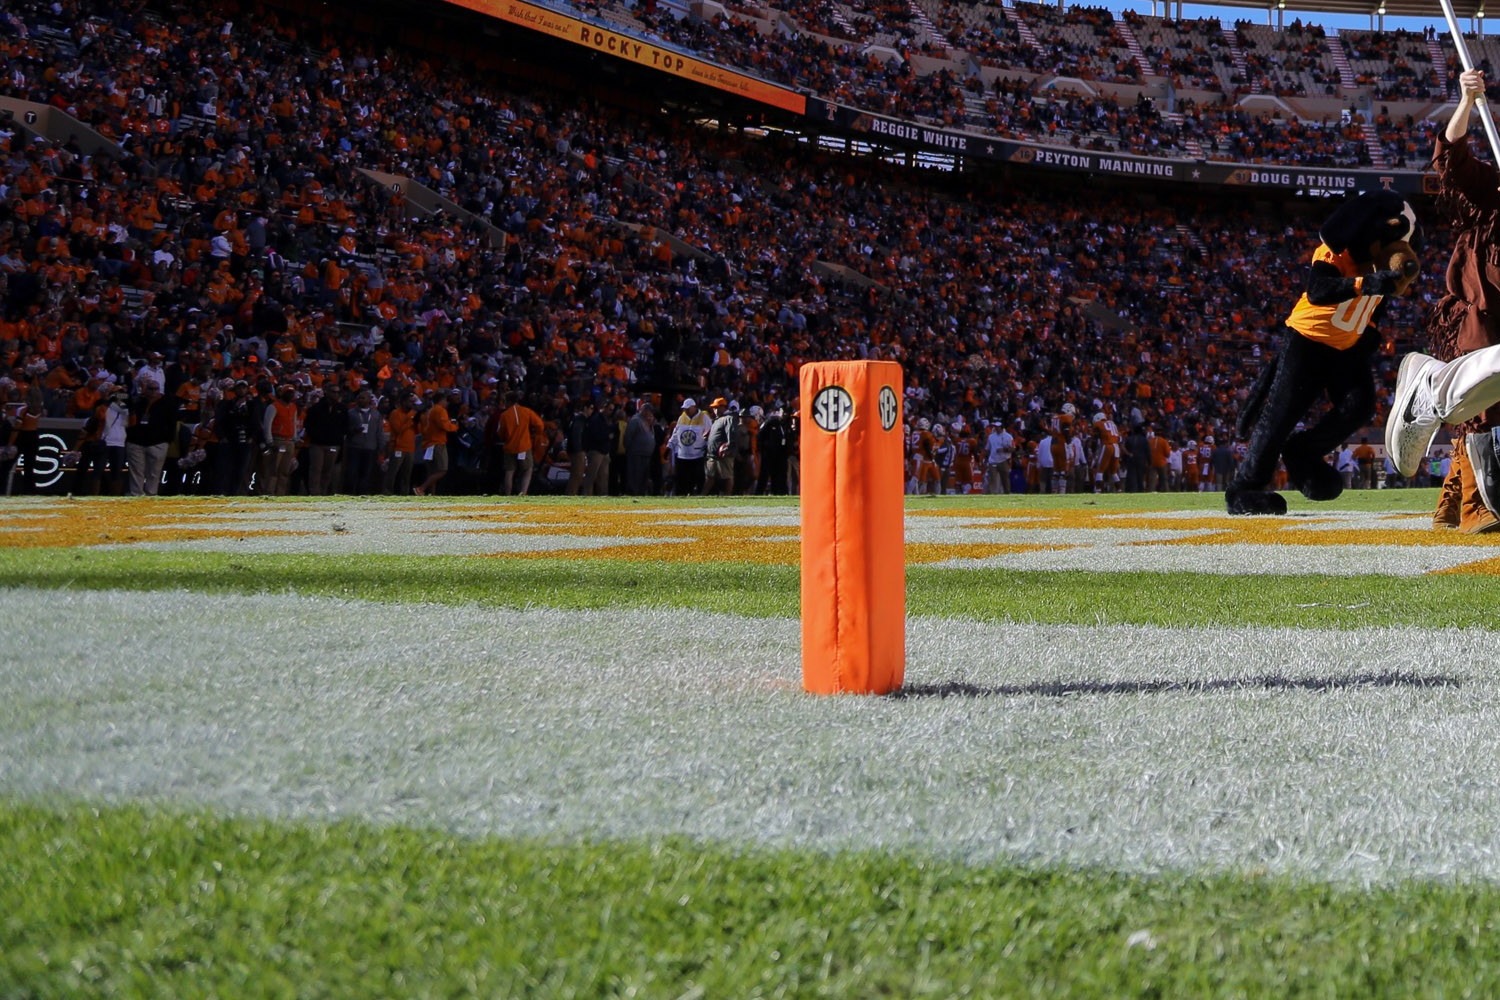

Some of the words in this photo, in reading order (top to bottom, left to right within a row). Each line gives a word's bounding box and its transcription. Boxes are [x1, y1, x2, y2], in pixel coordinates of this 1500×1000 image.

[580, 27, 642, 58] ROCKY
[652, 51, 684, 72] TOP
[27, 112, 35, 123] T
[826, 103, 838, 120] T
[872, 119, 919, 141] REGGIE
[923, 130, 967, 150] WHITE
[1035, 150, 1090, 169] PEYTON
[1099, 158, 1173, 177] MANNING
[1250, 172, 1290, 185] DOUG
[1296, 175, 1356, 188] ATKINS
[1380, 176, 1394, 191] T
[814, 388, 852, 430] SEC
[880, 388, 896, 430] SEC
[958, 441, 969, 455] 76
